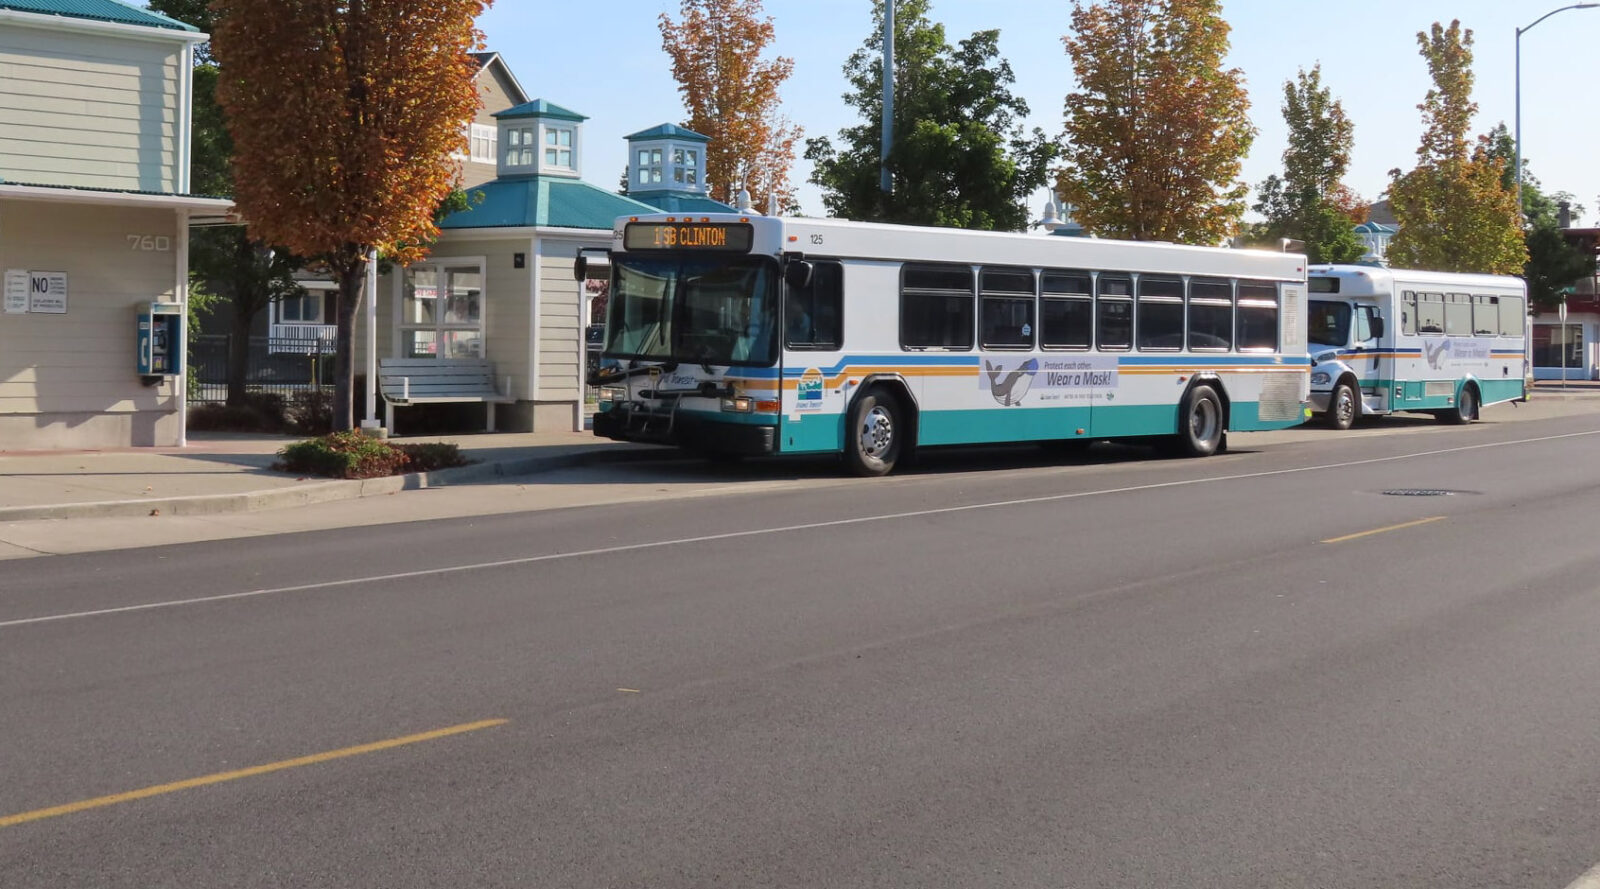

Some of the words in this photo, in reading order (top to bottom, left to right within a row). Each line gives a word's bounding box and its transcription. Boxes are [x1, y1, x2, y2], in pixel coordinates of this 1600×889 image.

[127, 235, 170, 250] 760
[663, 227, 677, 246] SB
[680, 227, 726, 246] CLINTON
[810, 234, 823, 245] 125
[32, 277, 48, 293] NO
[1044, 361, 1063, 370] Protect
[1064, 362, 1077, 370] each
[1047, 371, 1073, 386] Wear
[1074, 374, 1081, 386] a
[1083, 371, 1111, 386] Mask!
